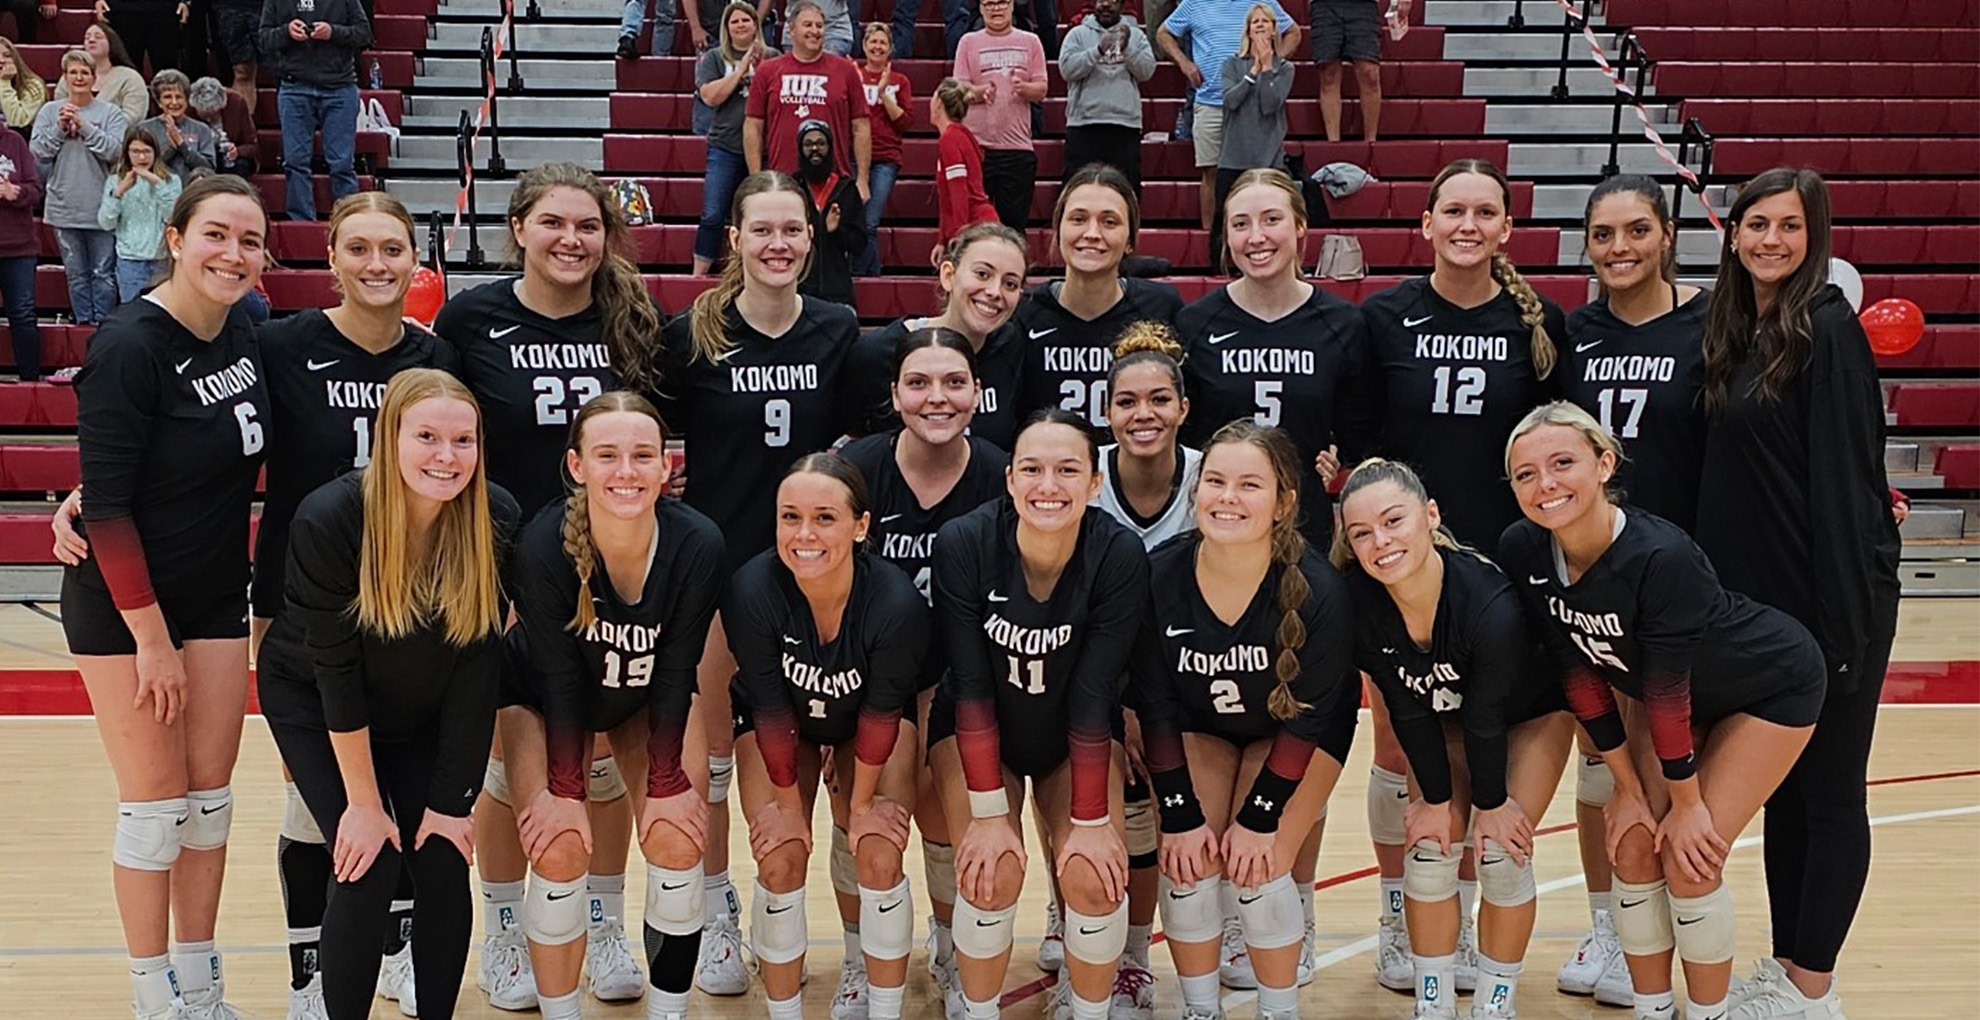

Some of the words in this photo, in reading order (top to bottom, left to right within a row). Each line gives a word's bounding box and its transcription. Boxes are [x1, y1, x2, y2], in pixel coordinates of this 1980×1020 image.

[780, 96, 826, 105] VOLLEYBALL
[781, 74, 828, 97] IUK
[510, 344, 611, 369] KOKOMO
[1222, 348, 1314, 375] KOKOMO
[1415, 334, 1507, 361] KOKOMO
[731, 364, 817, 392] KOKOMO
[1584, 356, 1675, 382] KOKOMO
[1254, 380, 1283, 428] 5
[1432, 366, 1486, 415] 12
[234, 401, 264, 456] 6
[764, 399, 790, 447] 9
[1598, 388, 1648, 438] 17
[585, 617, 661, 652] KOKOM
[984, 613, 1072, 655] KOKOMO
[602, 650, 655, 688] 19
[782, 652, 862, 698] KOKOMO
[1007, 655, 1046, 694] 11
[1177, 644, 1269, 676] KOKOMO
[808, 698, 827, 718] 1
[1210, 679, 1246, 714] 2
